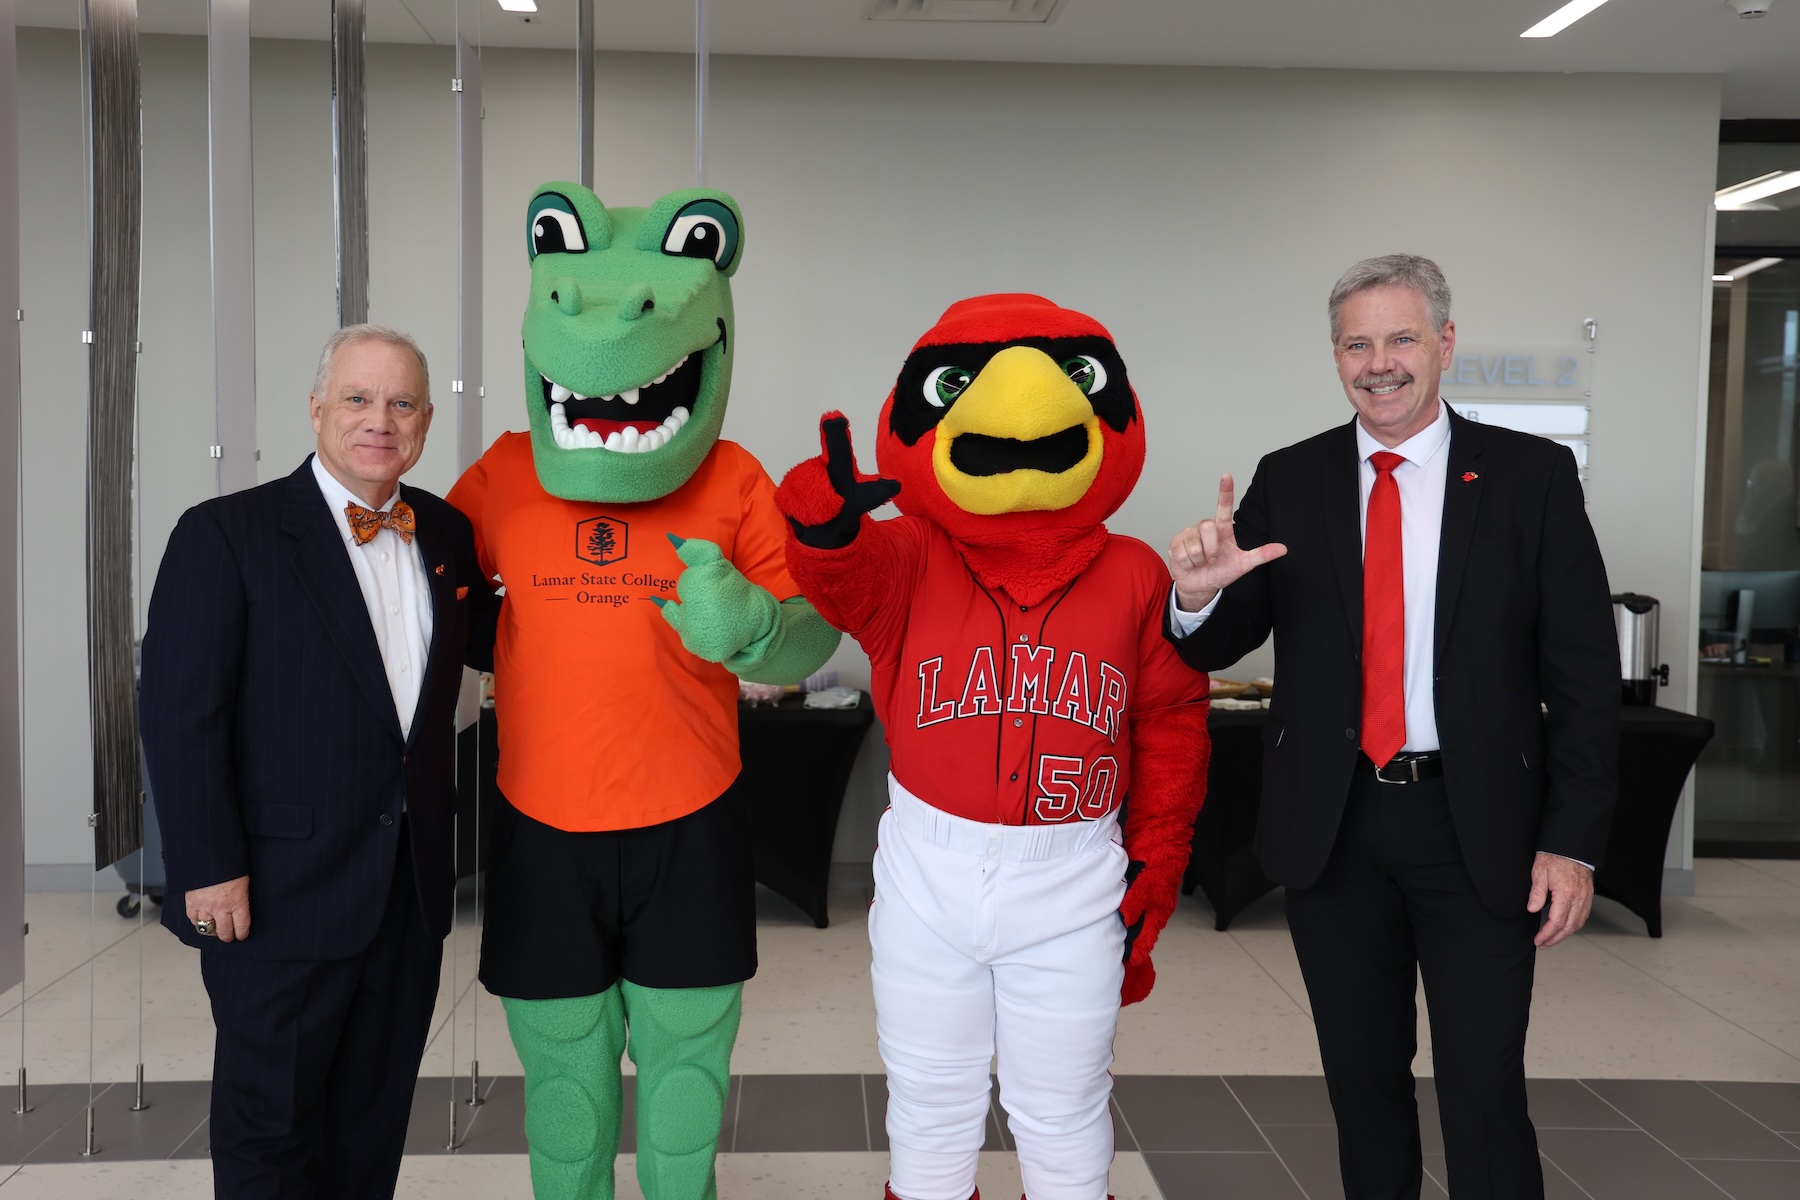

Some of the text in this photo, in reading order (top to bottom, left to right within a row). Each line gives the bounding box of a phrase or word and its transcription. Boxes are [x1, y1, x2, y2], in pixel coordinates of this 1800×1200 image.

[1557, 356, 1578, 386] 2
[532, 572, 677, 592] Lamar State College
[576, 591, 630, 608] Orange
[916, 643, 1128, 744] LAMAR
[1034, 754, 1118, 822] 50
